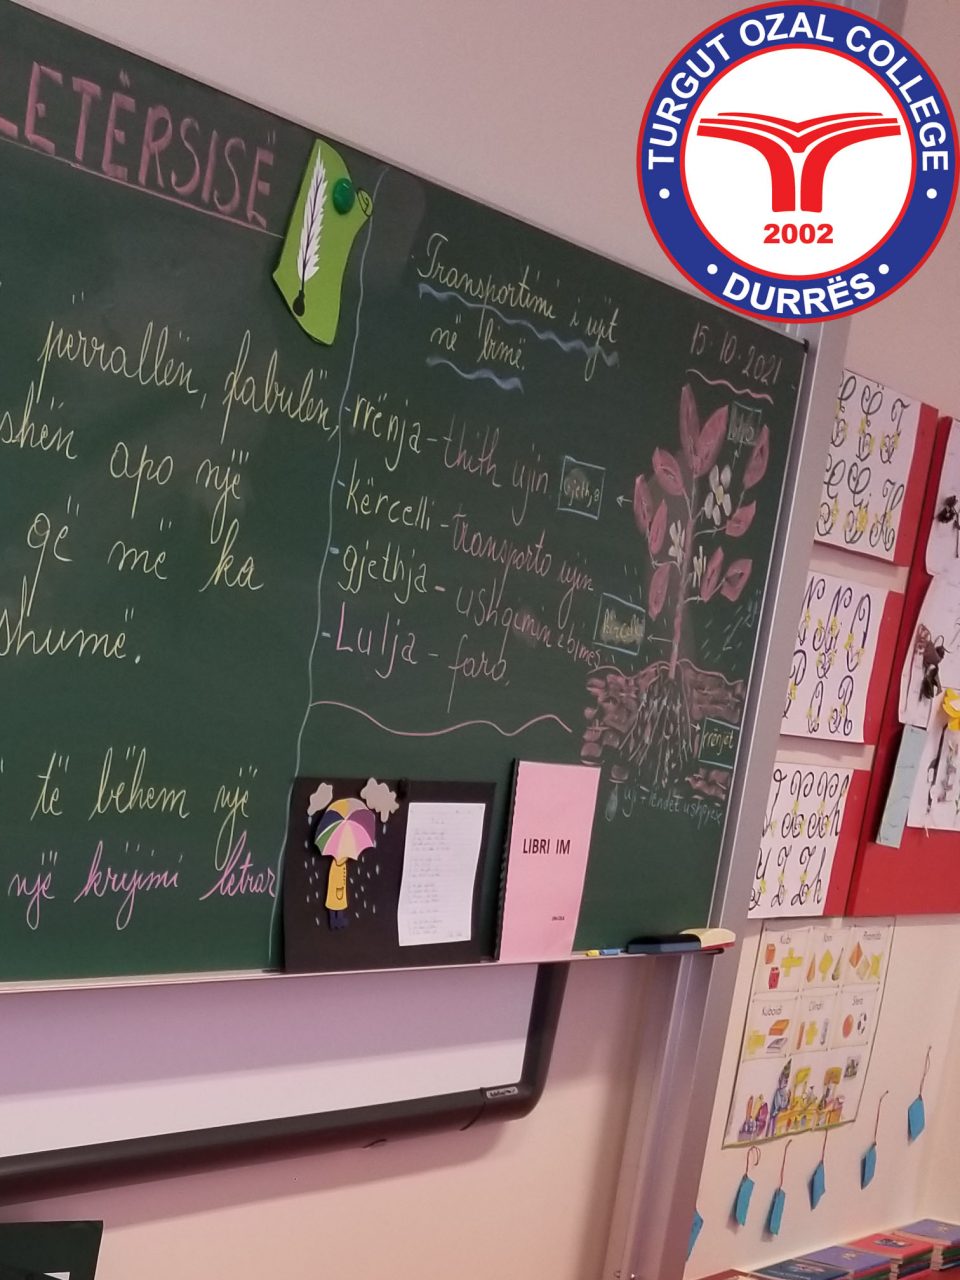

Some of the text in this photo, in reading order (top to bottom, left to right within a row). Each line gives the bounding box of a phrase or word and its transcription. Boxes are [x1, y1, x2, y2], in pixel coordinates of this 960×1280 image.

[110, 442, 173, 519] apo
[199, 518, 263, 592] ka
[522, 839, 571, 855] LIBRI IM
